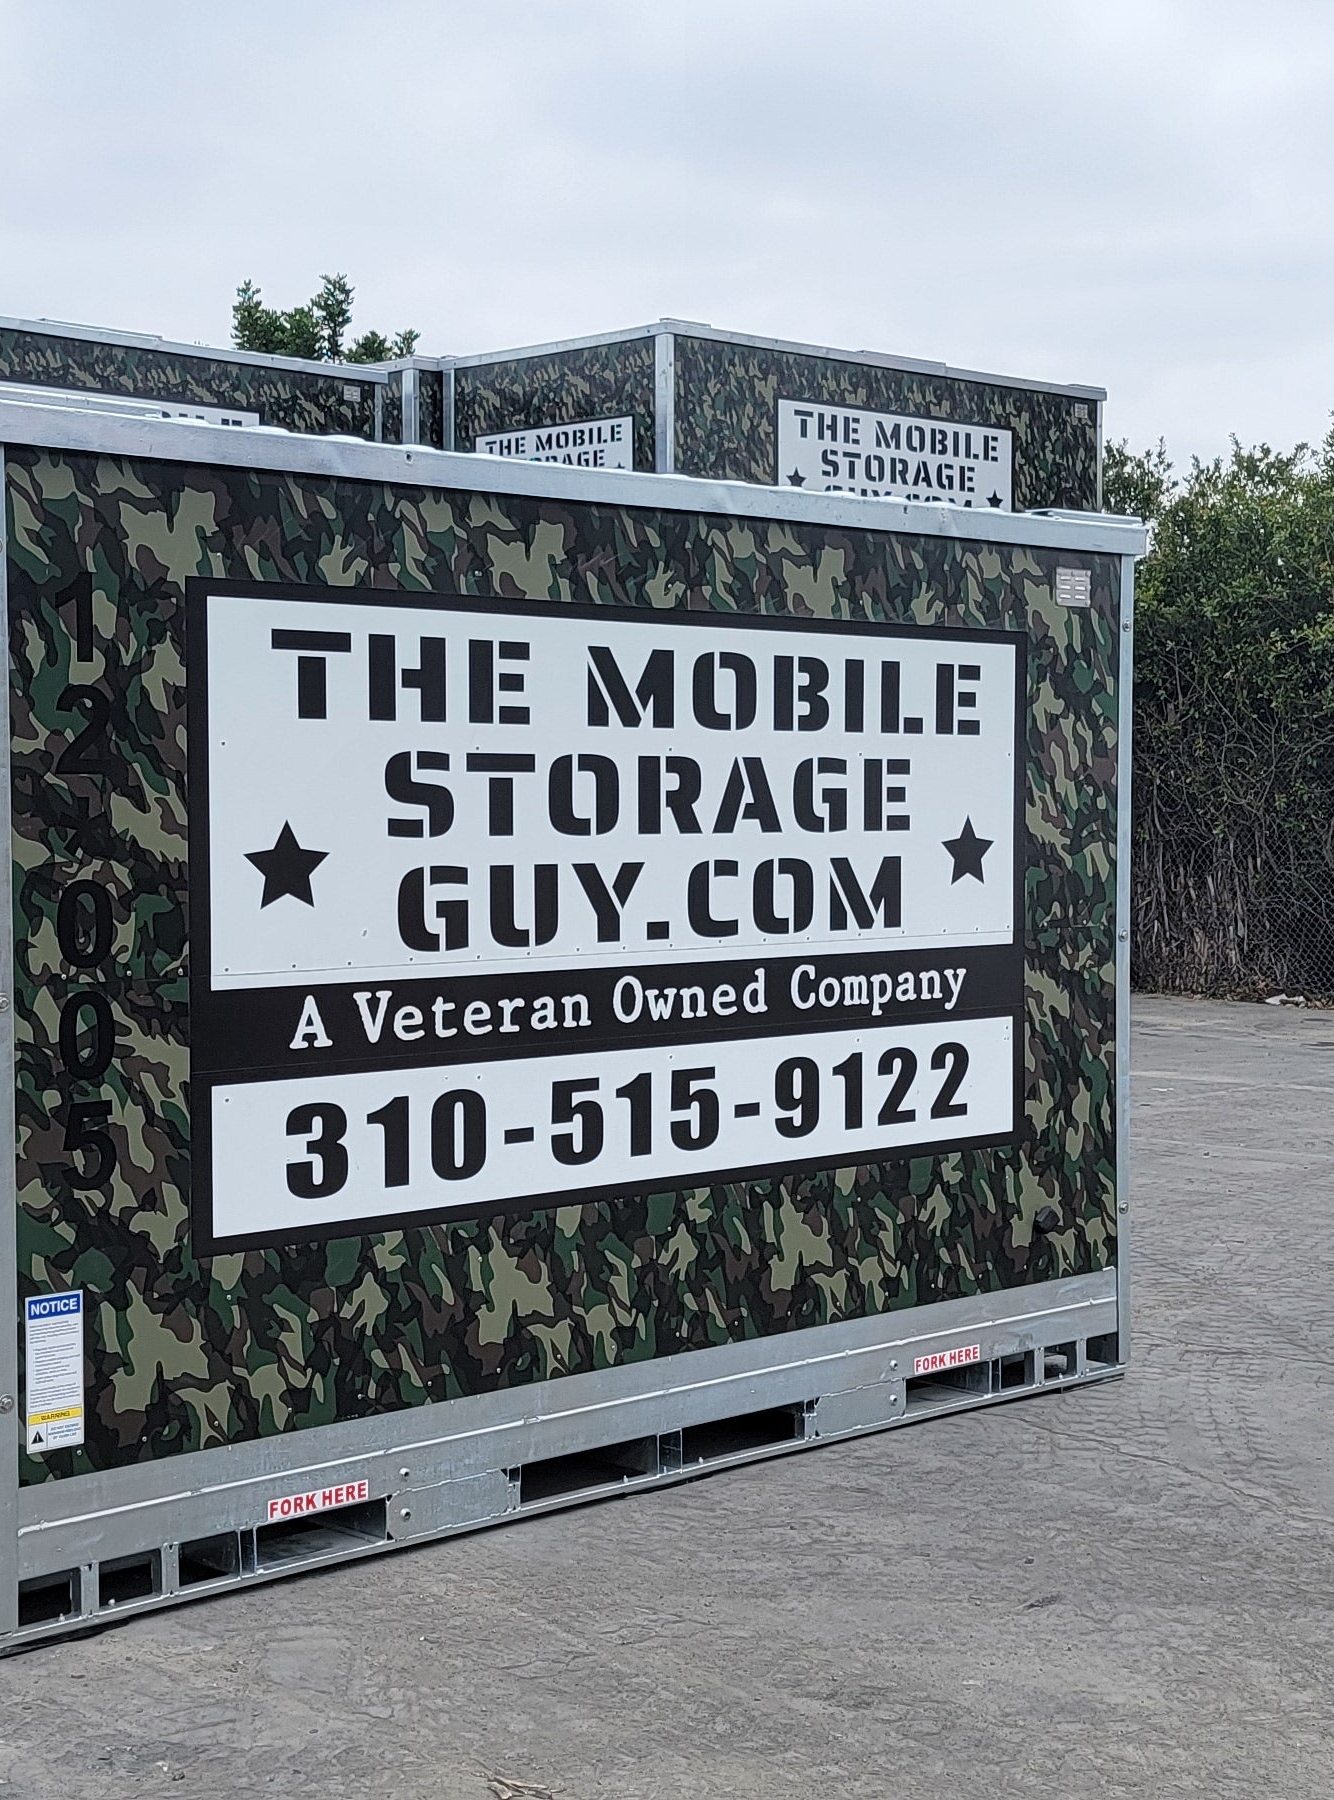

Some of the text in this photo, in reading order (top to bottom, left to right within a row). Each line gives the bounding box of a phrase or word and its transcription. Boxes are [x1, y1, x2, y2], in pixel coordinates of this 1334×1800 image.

[485, 424, 622, 456] THE MOBILE
[794, 410, 998, 462] THE MOBILE
[822, 449, 975, 493] STORAGE
[271, 629, 980, 735] THE MOBILE
[385, 751, 910, 838] STORAGE
[398, 856, 901, 952] GUY.COM
[290, 965, 966, 1049] A Veteran Owned Company
[286, 1042, 970, 1199] 310-515-9122
[30, 1298, 78, 1317] NOTICE
[915, 1346, 979, 1372] FORK HERE
[269, 1481, 367, 1519] FORK HERE
